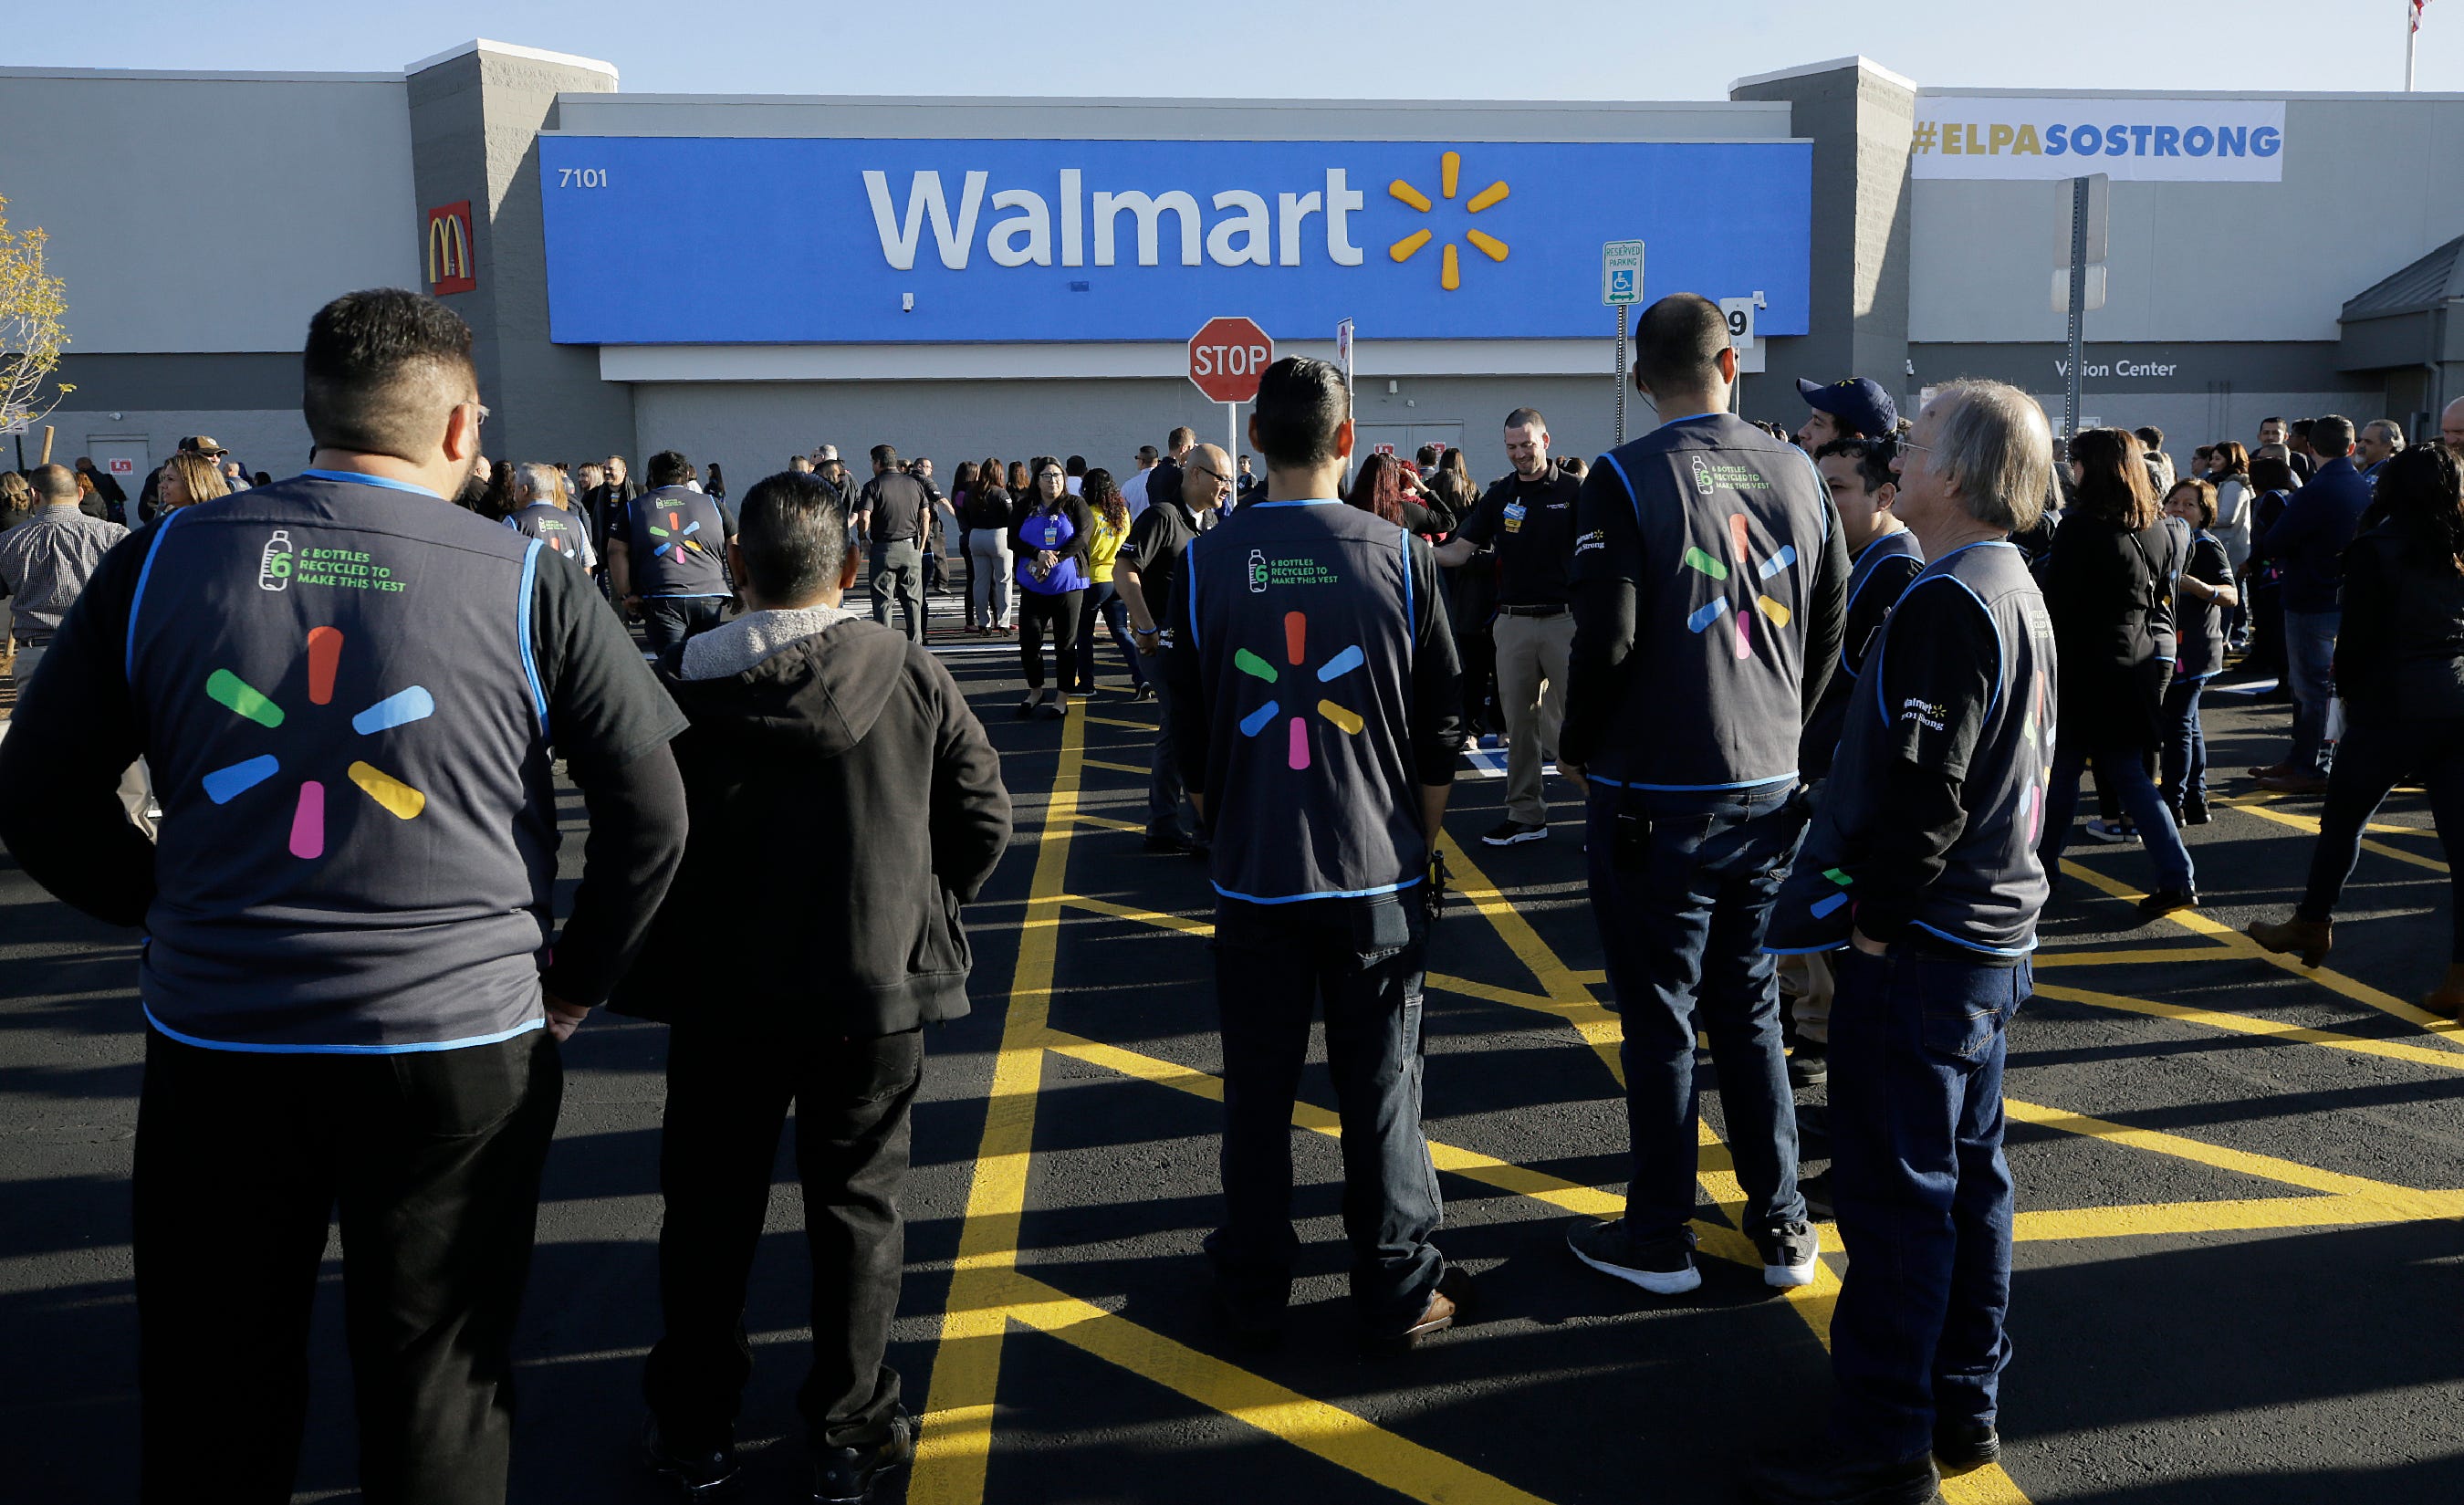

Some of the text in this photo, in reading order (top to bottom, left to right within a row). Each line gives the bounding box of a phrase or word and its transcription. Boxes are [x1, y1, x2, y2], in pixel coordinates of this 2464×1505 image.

[1913, 121, 2281, 157] #ELPASOSTRONG
[559, 168, 607, 188] 7101
[861, 168, 1363, 271] Walmart
[1606, 246, 1640, 256] RESERVED
[1609, 257, 1637, 267] PARKING
[1728, 310, 1747, 337] 9
[1194, 345, 1268, 376] STOP
[2054, 360, 2177, 377] Vion Center
[1714, 474, 1759, 482] RECYCLED TO
[270, 552, 294, 579] 6
[301, 548, 371, 563] 6 BOTTLES
[299, 559, 391, 579] RECYCLED TO
[1255, 565, 1269, 582] 6
[1271, 567, 1314, 576] RECYCLED
[297, 572, 406, 593] MAKE THIS VEST
